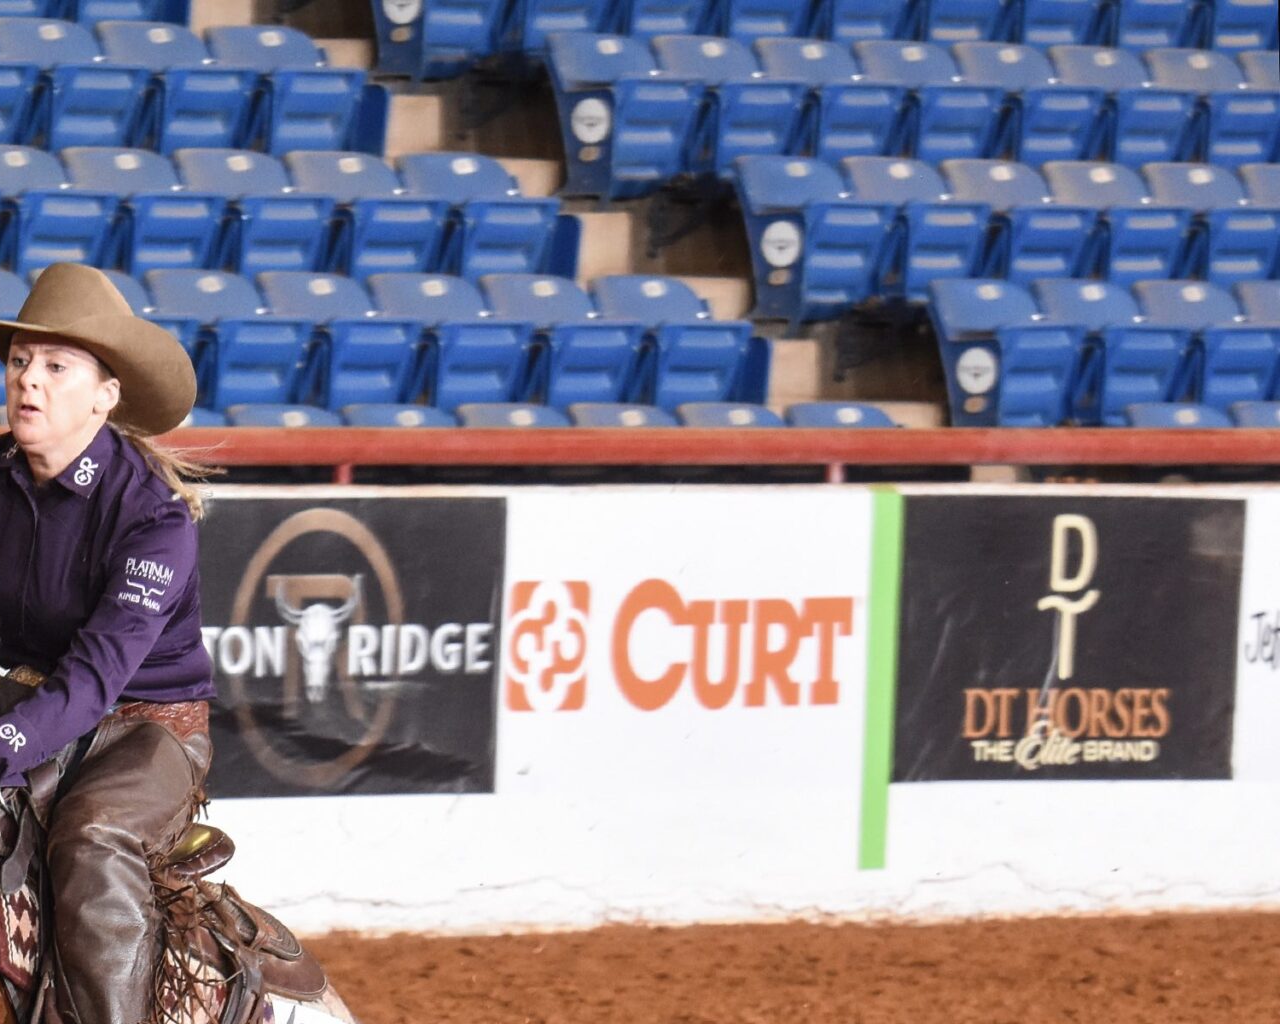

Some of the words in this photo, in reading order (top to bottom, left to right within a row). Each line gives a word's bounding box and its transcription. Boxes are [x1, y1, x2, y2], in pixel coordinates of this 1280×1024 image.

[125, 557, 174, 582] PLATINUM
[347, 622, 496, 677] RIDGE
[610, 577, 855, 712] CURT
[962, 687, 1020, 739] DT
[1025, 687, 1172, 739] HORSES
[971, 739, 1016, 762] THE
[1014, 719, 1083, 771] Elite
[1082, 739, 1161, 763] BRAND
